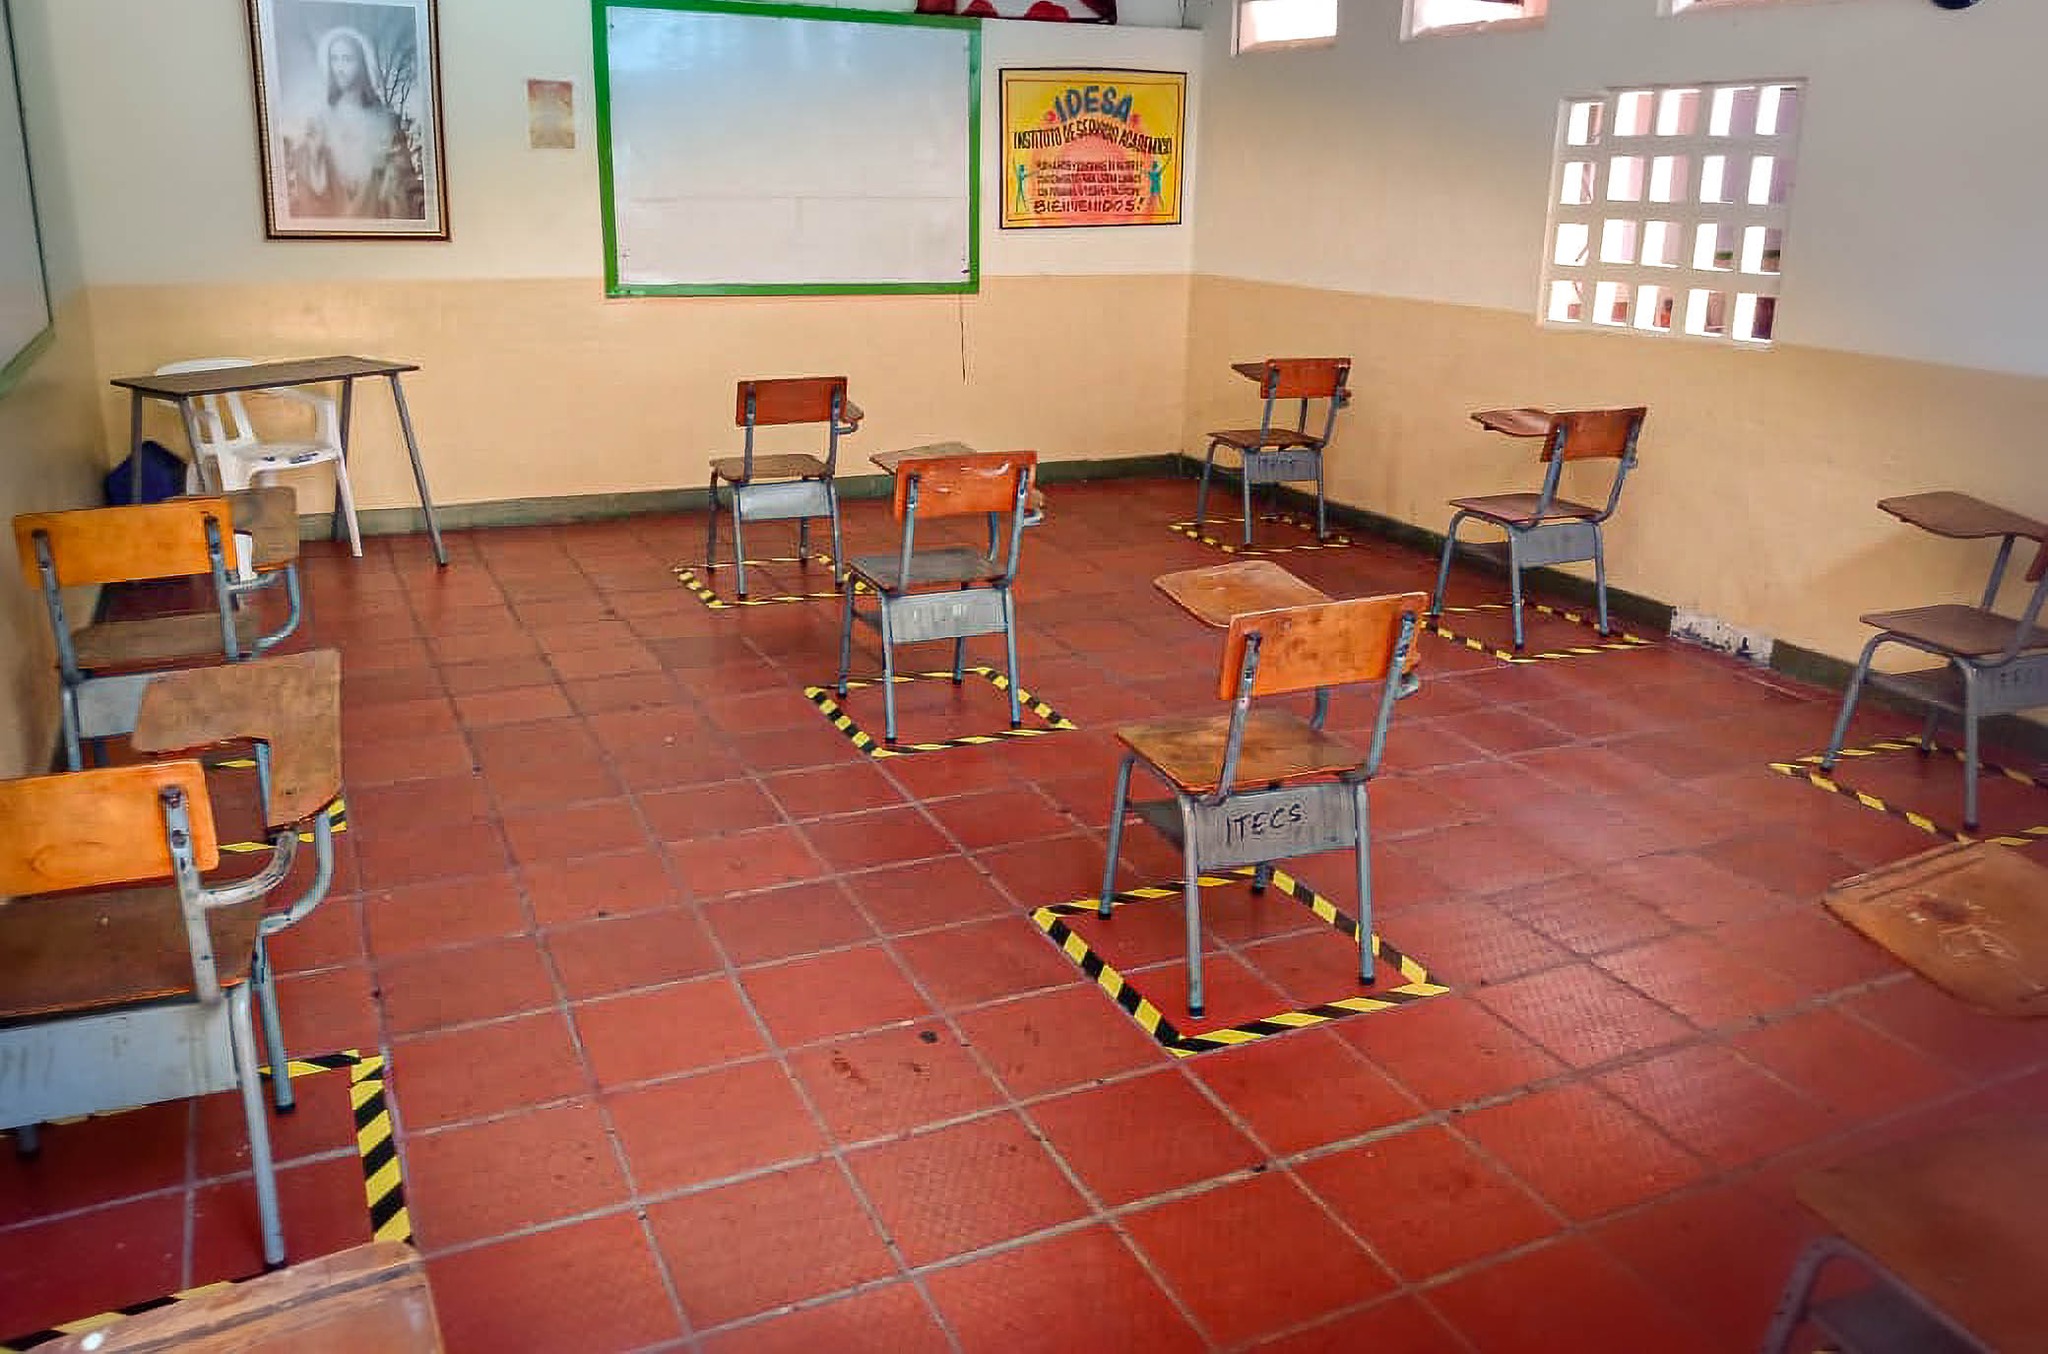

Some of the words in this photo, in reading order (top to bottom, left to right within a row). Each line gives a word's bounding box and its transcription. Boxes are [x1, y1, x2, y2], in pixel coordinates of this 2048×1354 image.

[1054, 85, 1133, 122] IDESA
[1013, 129, 1062, 149] INSTITUTO
[1063, 122, 1076, 143] DE
[1226, 803, 1301, 847] ITECS
